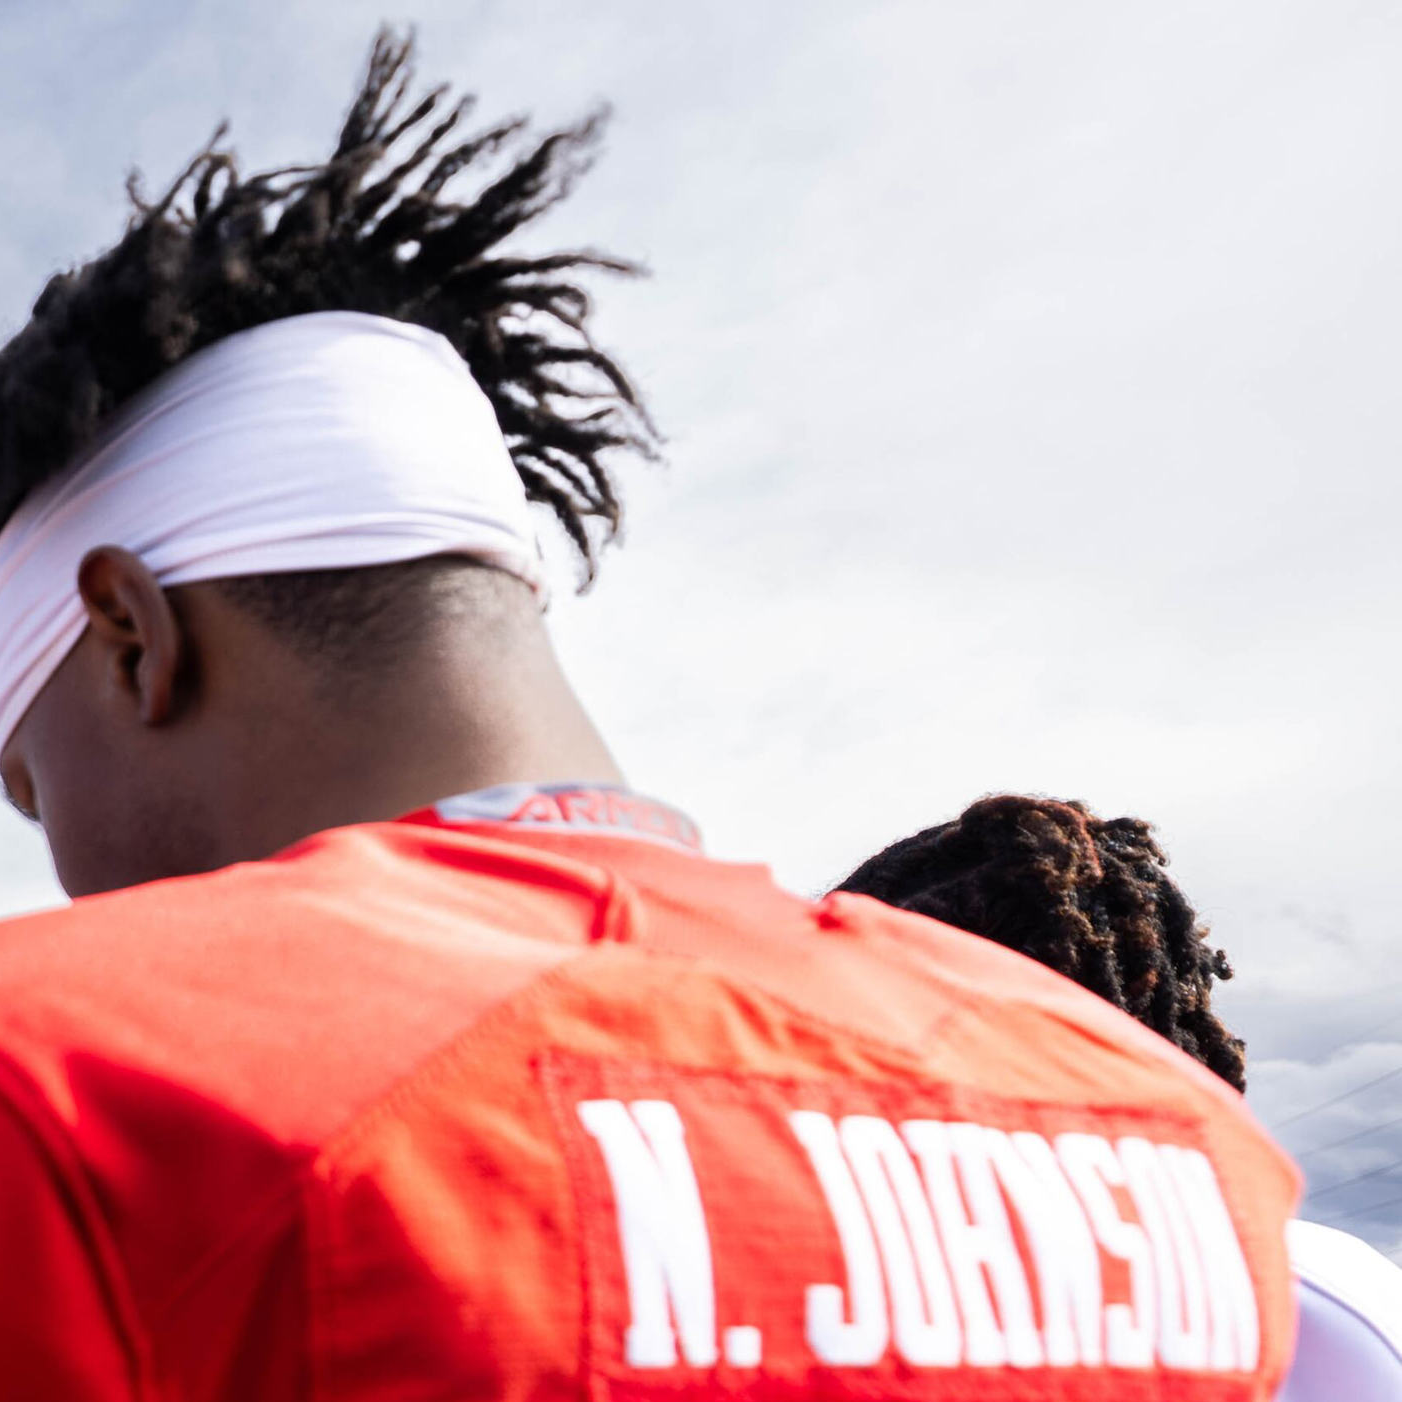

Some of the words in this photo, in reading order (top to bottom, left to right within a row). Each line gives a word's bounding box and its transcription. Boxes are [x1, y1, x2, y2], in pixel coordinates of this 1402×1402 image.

[507, 789, 701, 847] ARMOU
[577, 1099, 763, 1369] N.
[788, 1109, 1261, 1373] JOHNSON
